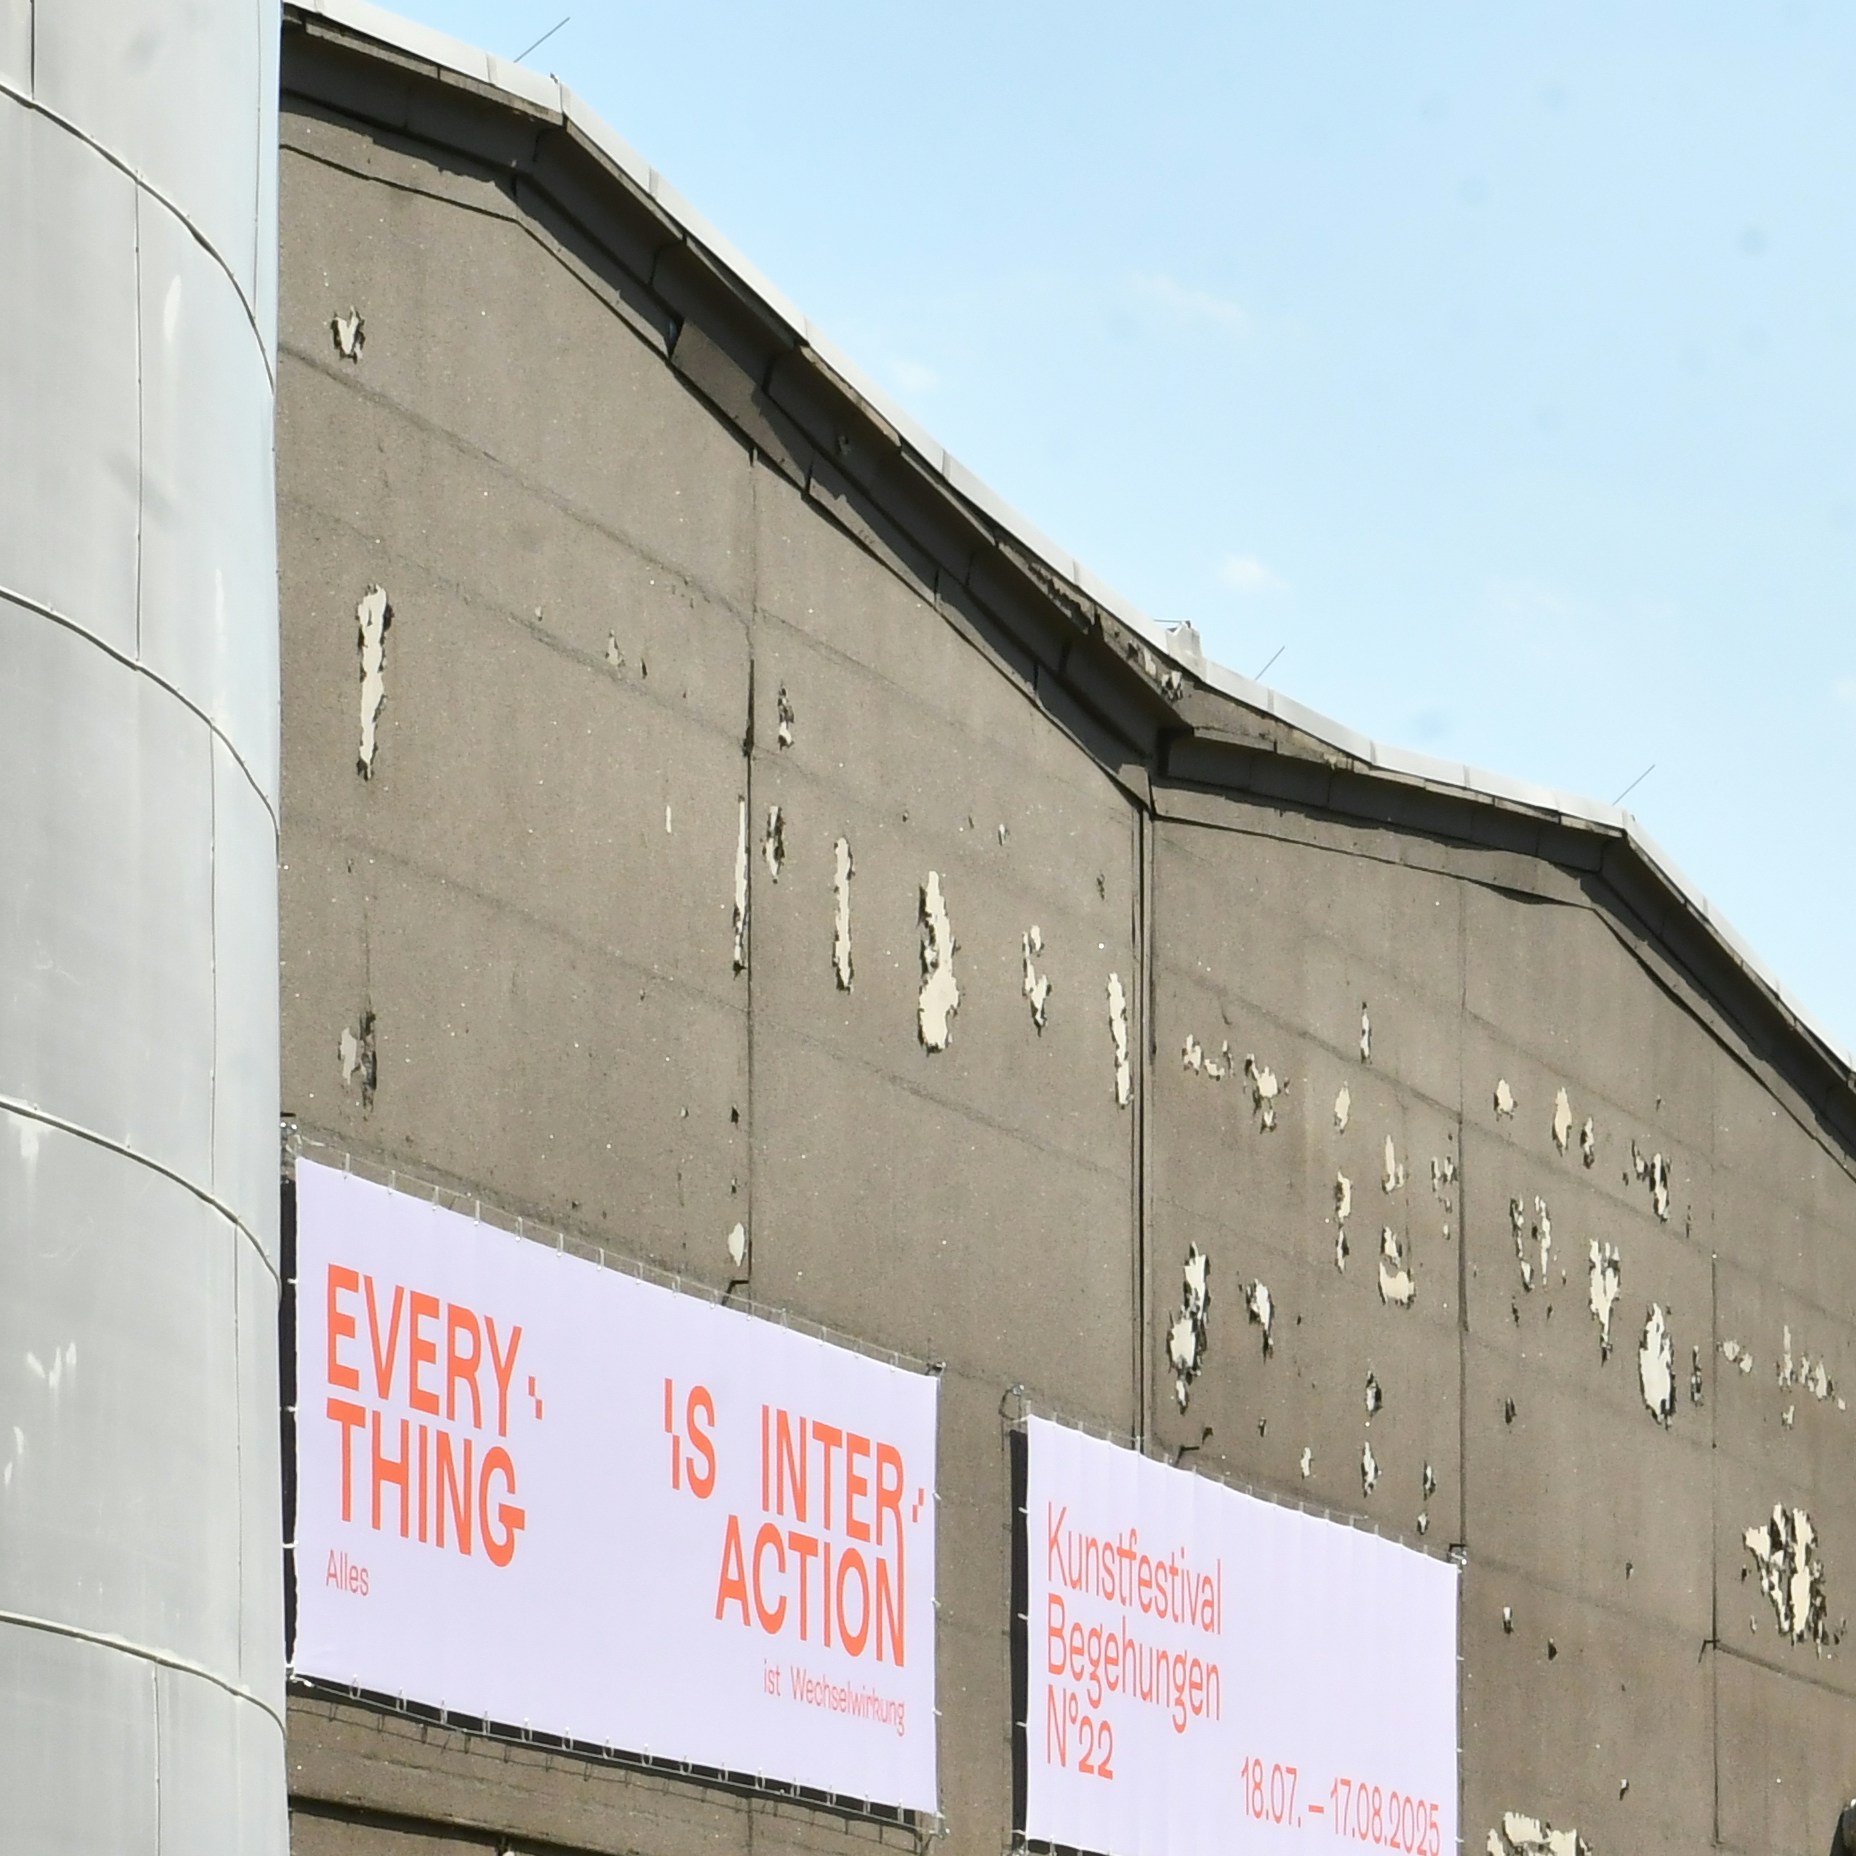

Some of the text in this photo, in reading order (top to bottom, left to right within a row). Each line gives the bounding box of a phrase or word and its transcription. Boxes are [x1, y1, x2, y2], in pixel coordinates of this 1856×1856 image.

[326, 1397, 527, 1568] THING
[664, 1378, 717, 1499] IS
[326, 1549, 370, 1597] Alles
[715, 1512, 906, 1668] ACTION
[1047, 1502, 1223, 1635] Kunstfestival
[764, 1658, 906, 1738] ist Wechselwirkung
[1047, 1592, 1221, 1734] Begehungen
